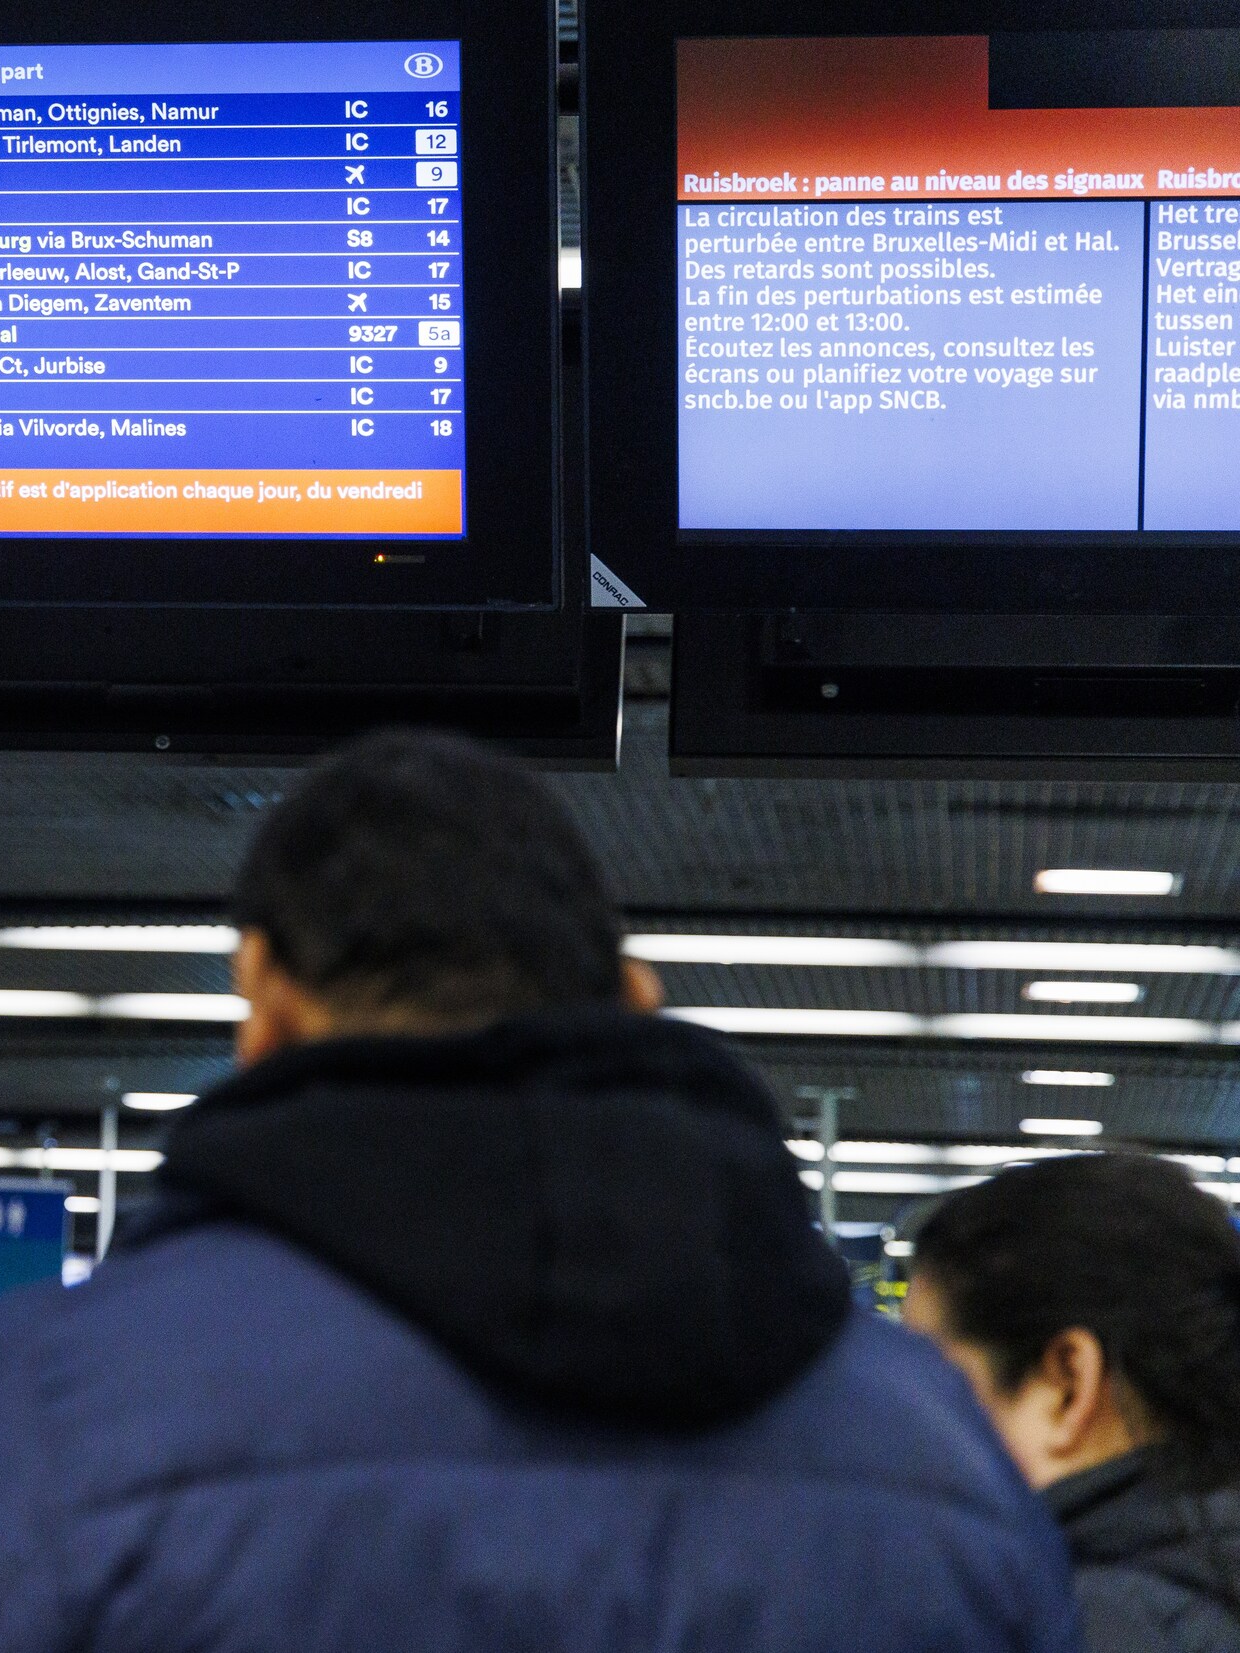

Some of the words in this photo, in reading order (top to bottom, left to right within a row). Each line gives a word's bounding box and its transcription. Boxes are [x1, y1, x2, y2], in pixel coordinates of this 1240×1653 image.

[48, 102, 145, 125] Ottignies,
[152, 103, 219, 120] Namur
[2, 135, 103, 156] Tirlemont,
[109, 134, 181, 153] Landen
[684, 171, 798, 193] Ruisbroek
[815, 176, 885, 196] panne
[890, 176, 919, 192] au
[925, 169, 1001, 192] niveau
[1006, 170, 1049, 191] des
[1053, 168, 1145, 196] signaux
[686, 208, 710, 227] La
[718, 206, 838, 227] circulation
[846, 206, 886, 226] des
[893, 205, 959, 225] trains
[968, 207, 1003, 225] est
[37, 231, 65, 249] via
[71, 230, 212, 249] Brux-Schuman
[686, 232, 797, 255] perturbée
[805, 235, 865, 253] entre
[873, 230, 1037, 252] Bruxelles-Midi
[1045, 233, 1068, 251] et
[1076, 230, 1119, 251] Hal.
[75, 262, 132, 283] Alost,
[138, 262, 240, 280] Gand-St-P
[686, 261, 725, 279] Des
[734, 259, 814, 279] retards
[821, 261, 873, 279] sont
[881, 257, 995, 282] possibles.
[686, 287, 710, 306] La
[717, 285, 748, 305] fin
[756, 285, 796, 305] des
[804, 284, 961, 308] perturbations
[969, 286, 1004, 305] est
[1011, 283, 1102, 304] estimée
[685, 314, 744, 332] entre
[751, 313, 808, 332] 12:00
[816, 313, 839, 332] et
[845, 312, 910, 332] 13:00.
[1154, 312, 1232, 330] tussen
[349, 325, 398, 342] 9327
[686, 336, 773, 358] Écoutez
[780, 337, 812, 358] les
[819, 342, 936, 361] annonces,
[943, 336, 1055, 357] consultez
[1062, 336, 1094, 357] les
[1155, 335, 1236, 357] Luister
[34, 356, 105, 374] Jurbise
[685, 363, 759, 383] écrans
[766, 368, 794, 384] ou
[803, 363, 901, 388] planifiez
[908, 365, 967, 383] votre
[974, 367, 1053, 388] voyage
[1060, 368, 1098, 383] sur
[685, 389, 772, 409] sncb.be
[780, 394, 807, 409] ou
[816, 389, 872, 413] l'app
[879, 390, 946, 409] SNCB.
[19, 418, 105, 439] Vilvorde,
[111, 418, 186, 436] Malines
[18, 482, 48, 498] est
[52, 480, 178, 502] d'application
[182, 480, 254, 503] chaque
[257, 480, 302, 503] jour,
[306, 480, 332, 499] du
[336, 480, 422, 499] vendredi
[592, 571, 629, 606] CONRAC
